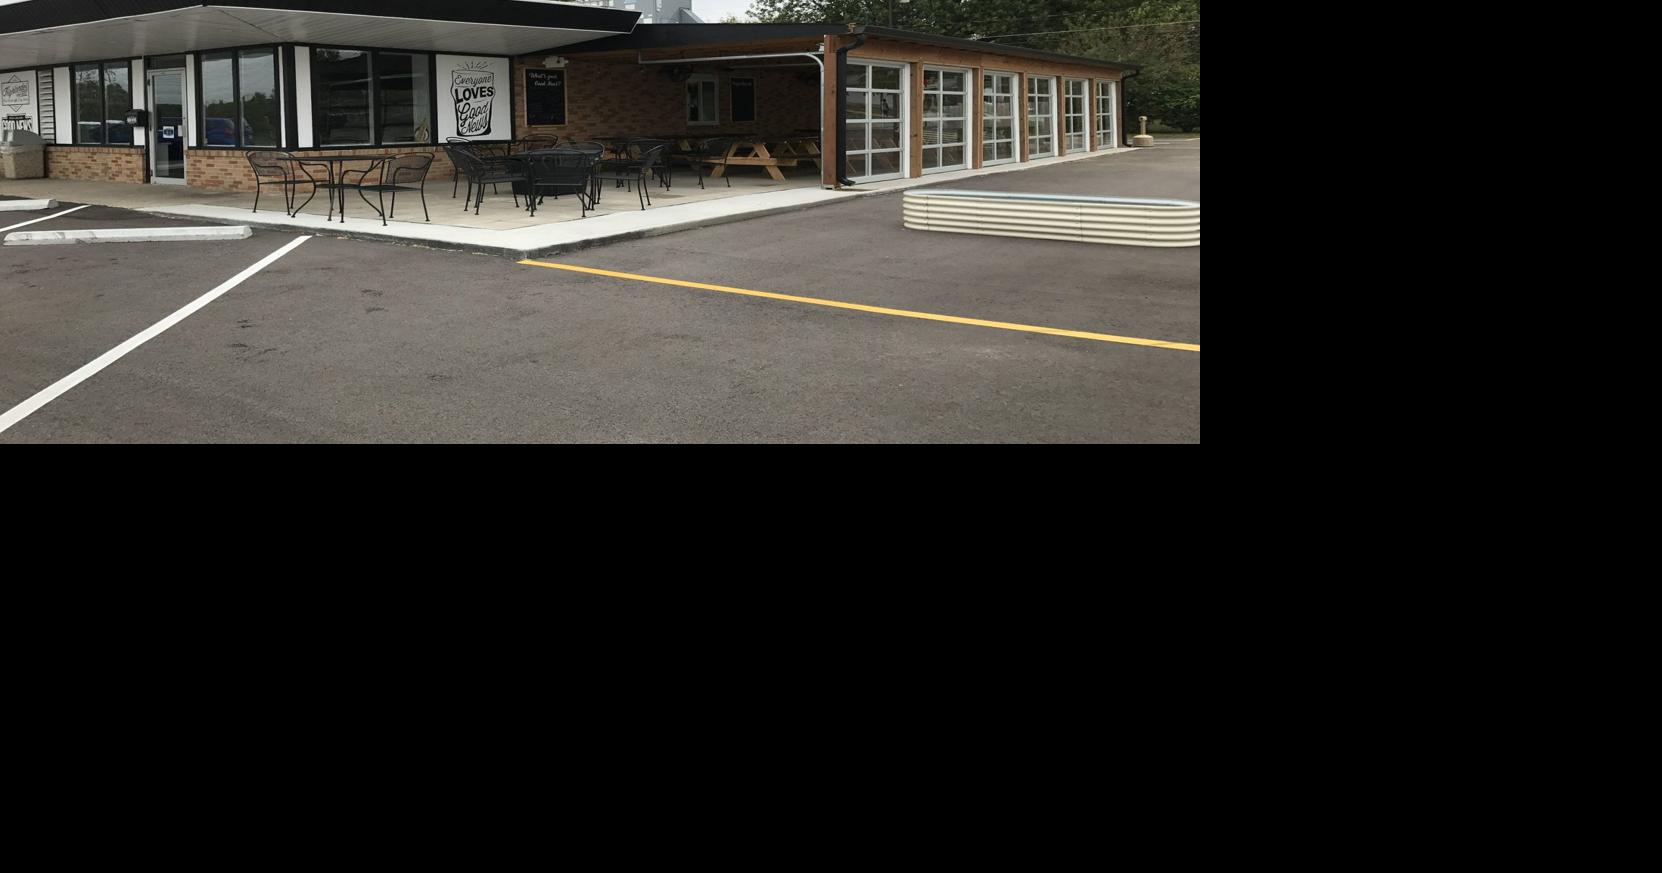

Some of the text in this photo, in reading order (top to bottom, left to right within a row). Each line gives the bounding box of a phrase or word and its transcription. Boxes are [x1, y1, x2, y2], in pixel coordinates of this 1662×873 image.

[455, 75, 492, 87] Everyone
[455, 87, 494, 104] LOVES
[458, 102, 489, 127] Good
